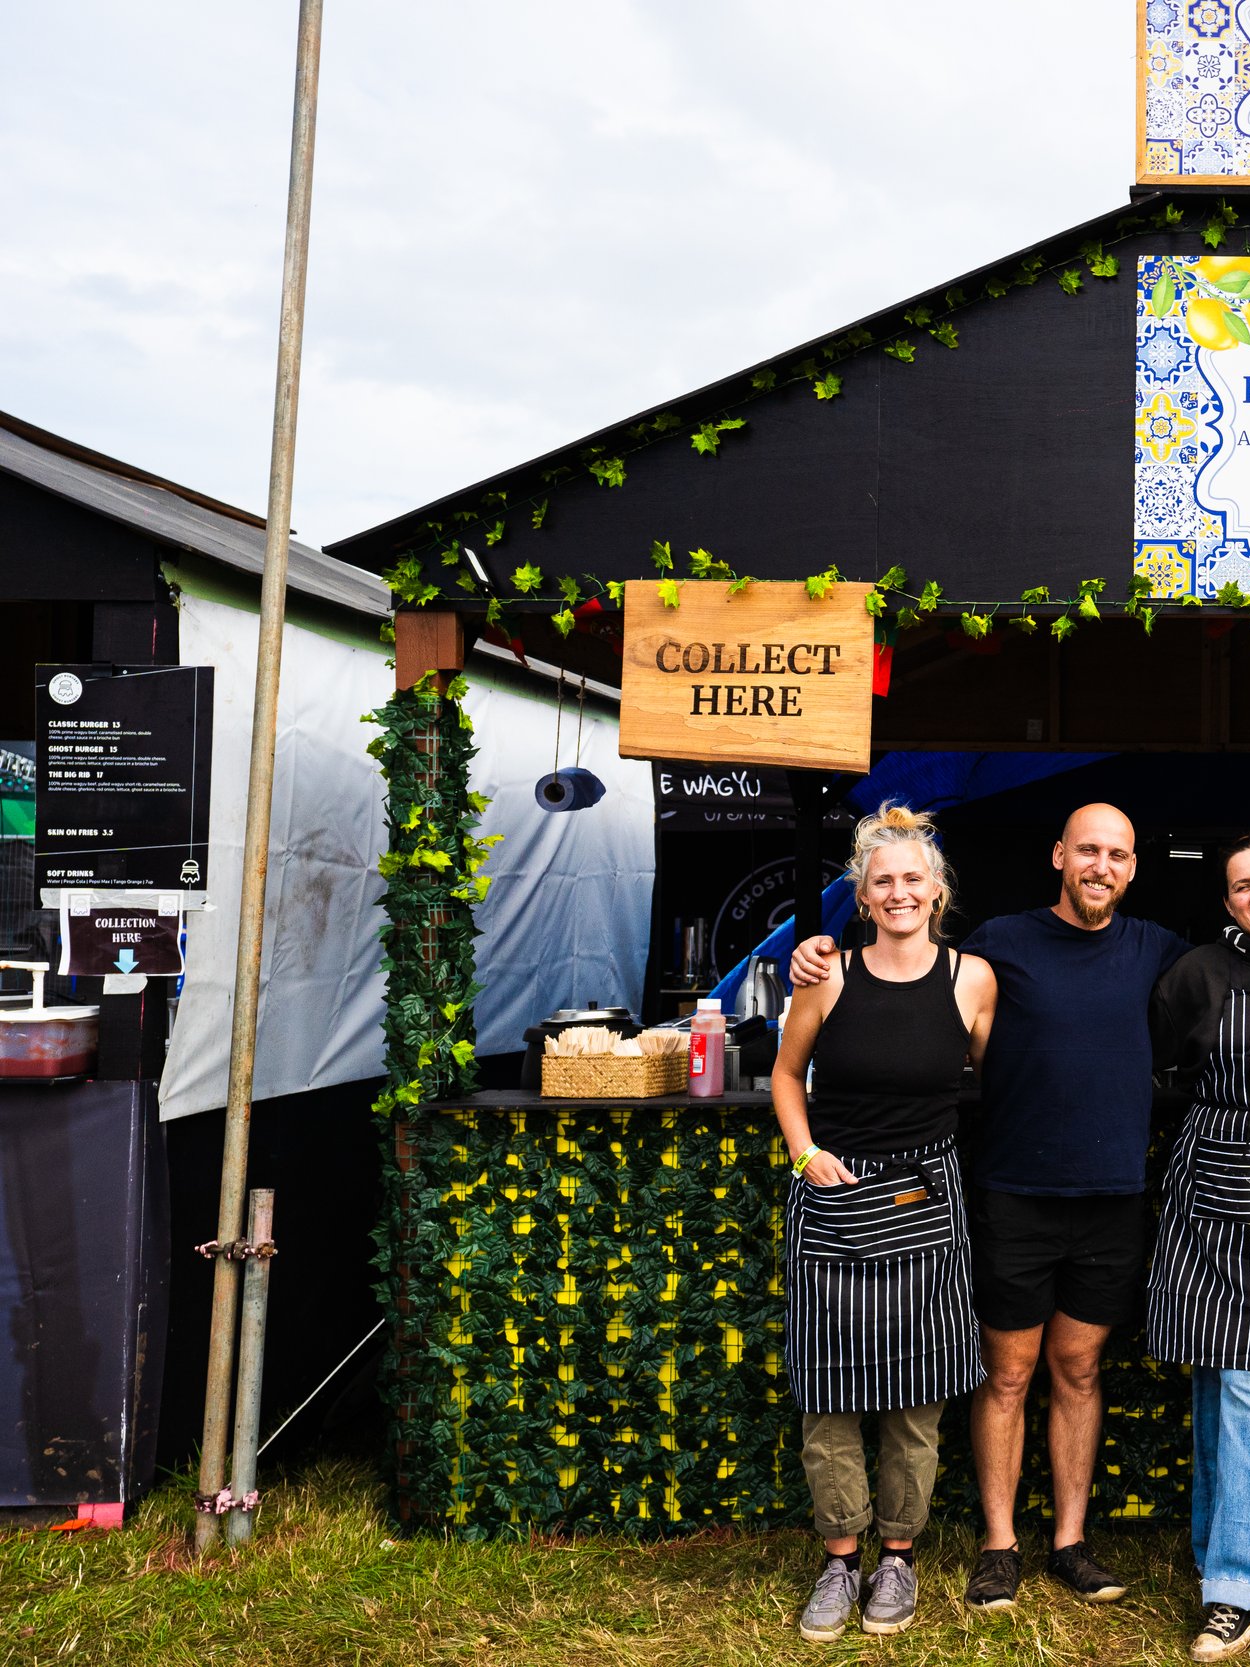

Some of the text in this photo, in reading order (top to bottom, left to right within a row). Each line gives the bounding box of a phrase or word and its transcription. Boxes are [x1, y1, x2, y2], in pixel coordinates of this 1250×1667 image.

[655, 641, 841, 675] COLLECT
[689, 684, 803, 717] HERE
[683, 771, 761, 797] WAGYU
[731, 870, 786, 921] GHOST
[95, 918, 156, 928] COLLECTION
[112, 932, 142, 943] HERE
